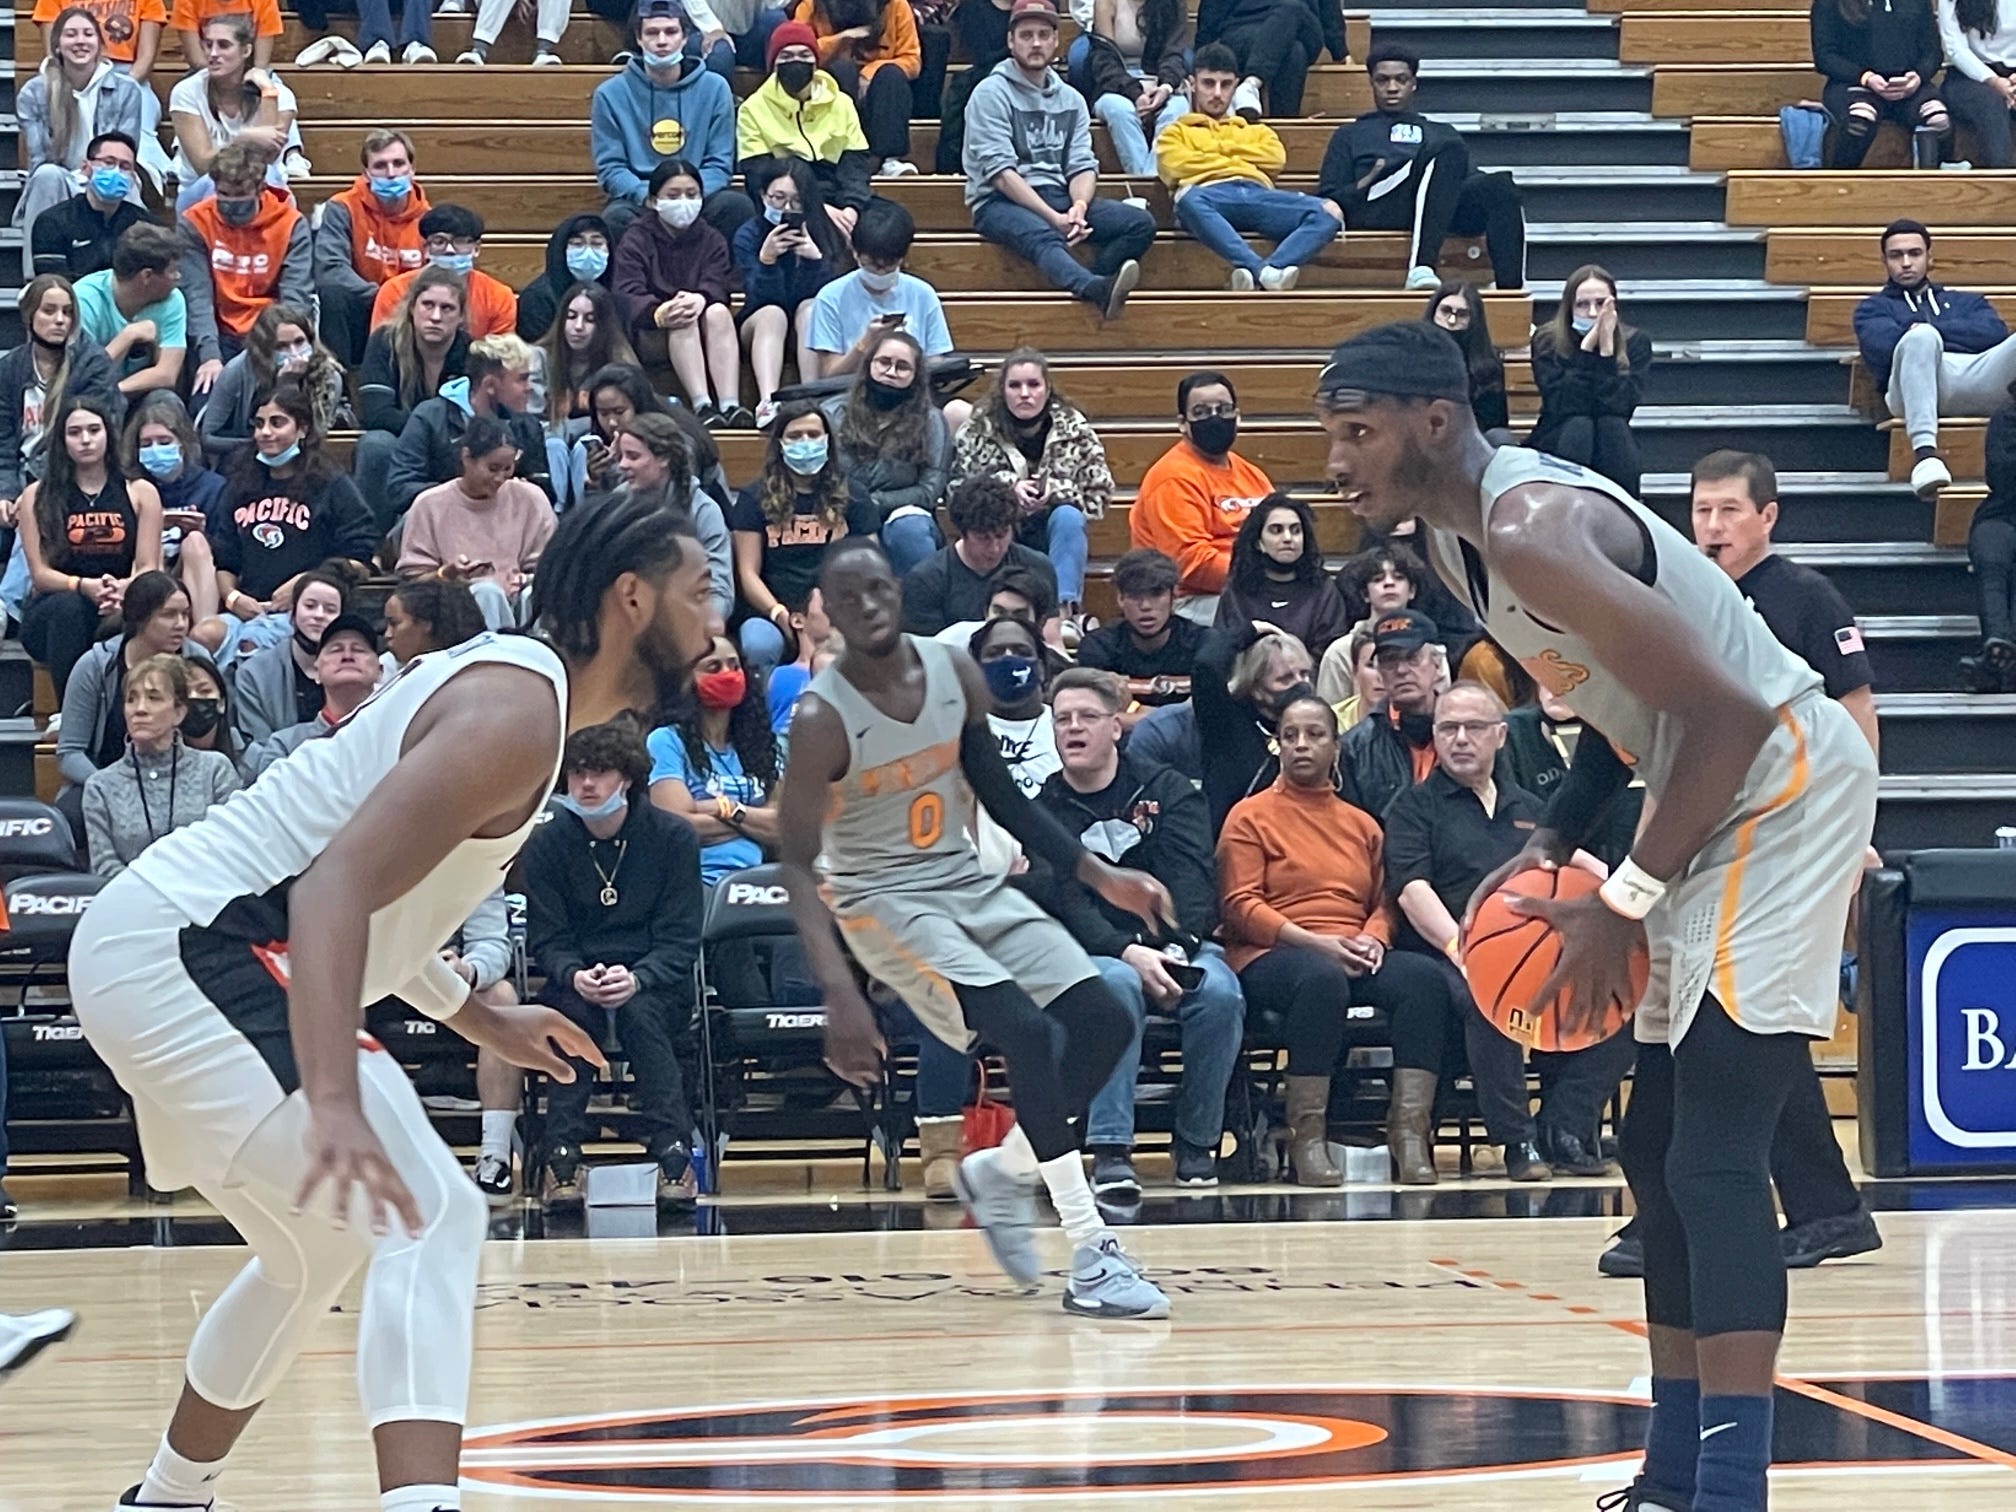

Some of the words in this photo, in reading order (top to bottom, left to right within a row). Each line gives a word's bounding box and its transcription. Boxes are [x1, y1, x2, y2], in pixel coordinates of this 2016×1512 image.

[67, 513, 125, 528] PACIFIC
[234, 497, 311, 530] PACIFIC
[0, 817, 53, 838] IFIC
[908, 790, 944, 851] 0
[9, 893, 97, 915] PACIF
[404, 1020, 437, 1034] TIG
[1960, 1008, 2016, 1071] B
